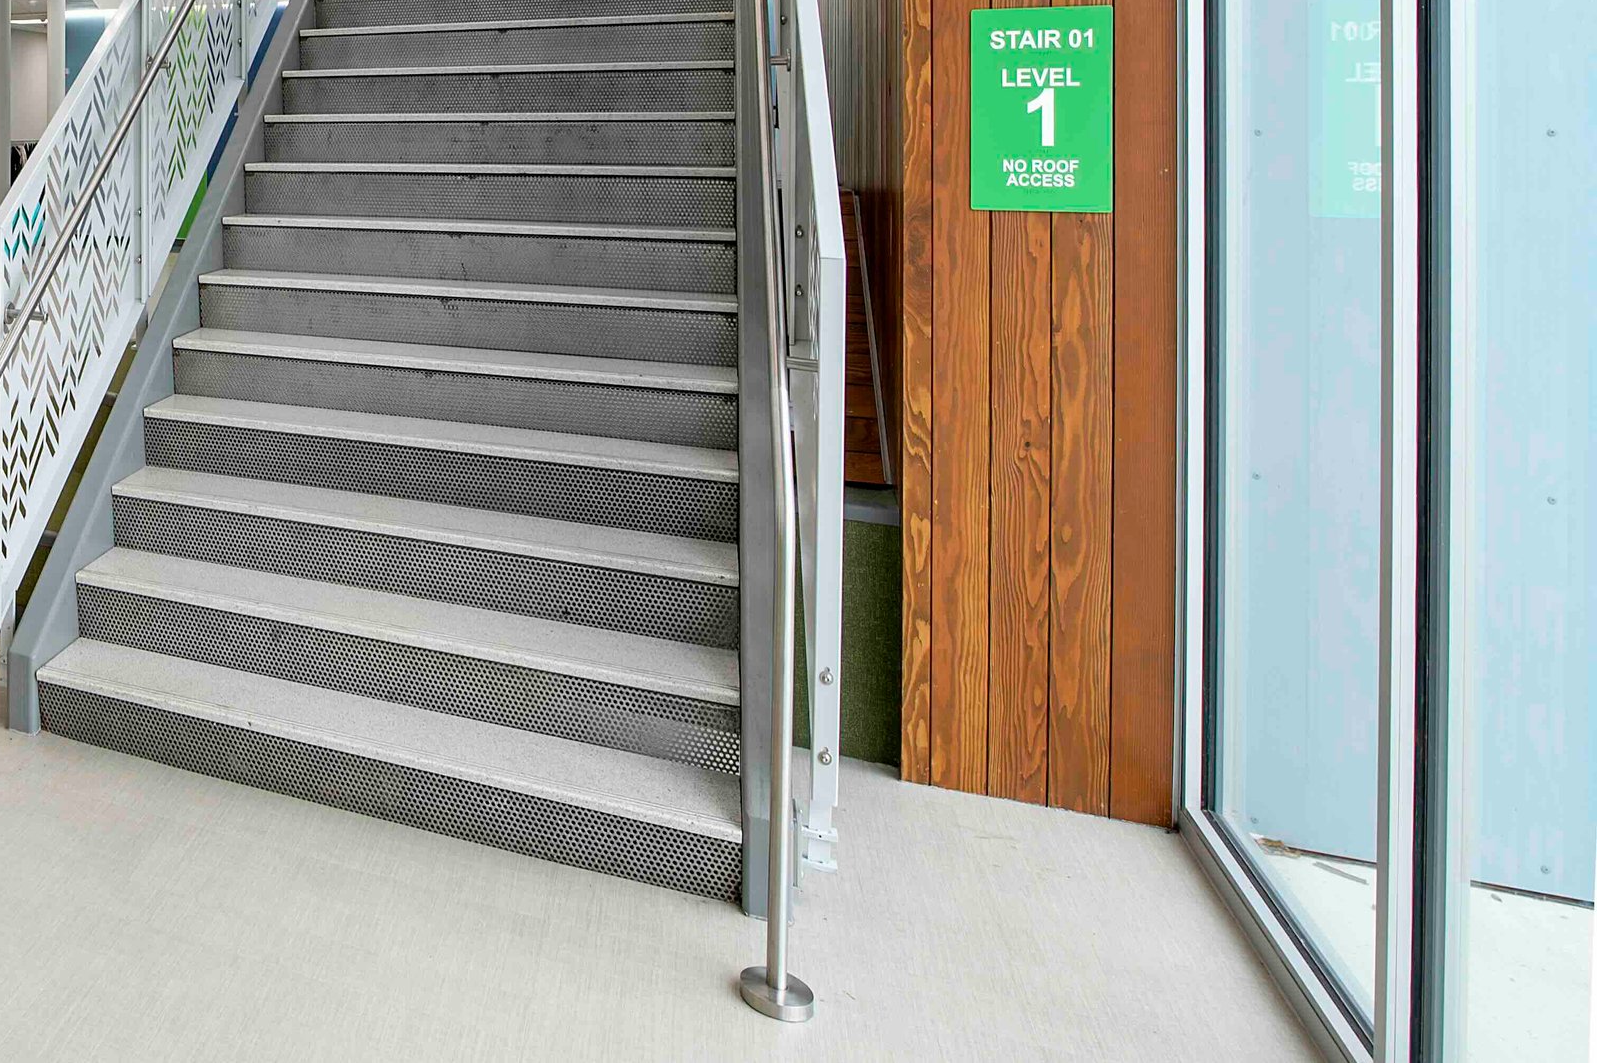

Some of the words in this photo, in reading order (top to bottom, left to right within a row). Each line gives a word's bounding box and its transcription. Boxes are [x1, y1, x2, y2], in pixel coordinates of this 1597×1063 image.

[989, 29, 1062, 50] STAIR
[1068, 28, 1094, 49] 01
[1001, 67, 1081, 88] LEVEL
[1026, 87, 1055, 147] 1
[1002, 159, 1028, 173] NO
[1031, 159, 1080, 173] ROOF
[1005, 173, 1075, 188] ACCESS
